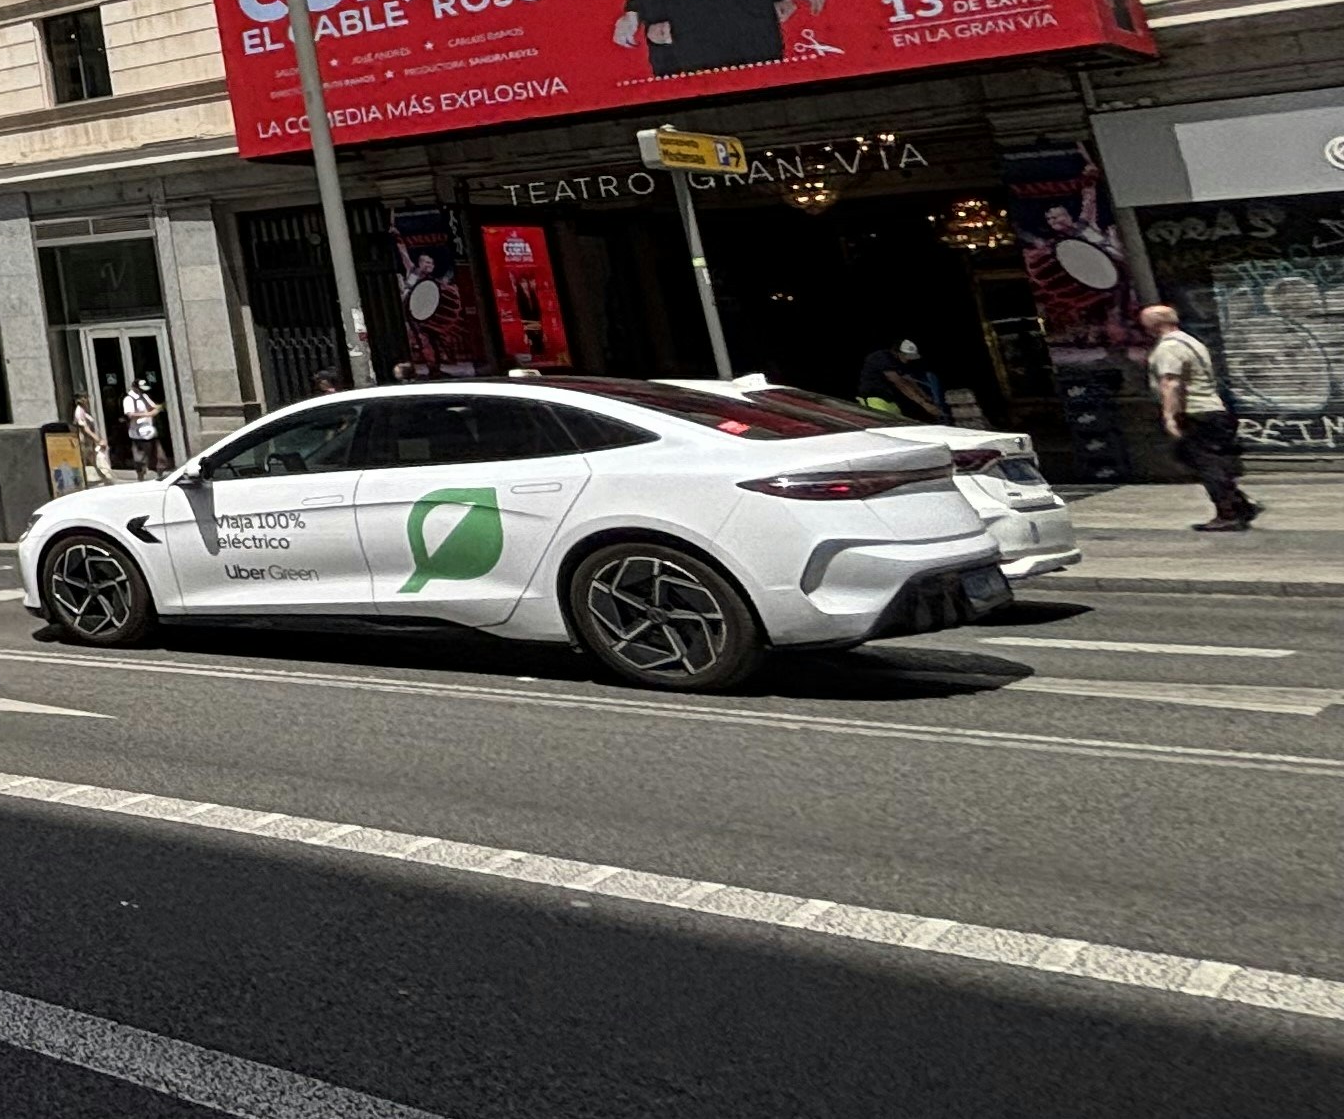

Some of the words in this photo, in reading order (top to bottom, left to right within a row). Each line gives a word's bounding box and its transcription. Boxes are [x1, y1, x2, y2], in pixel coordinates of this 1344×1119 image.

[242, 27, 285, 55] EL
[893, 31, 921, 47] EN
[925, 28, 952, 43] LA
[955, 17, 1016, 38] GRAN
[1016, 11, 1059, 29] VÍA
[257, 119, 282, 139] LA
[387, 92, 436, 119] MÁS
[439, 75, 569, 112] EXPLOSIVA
[502, 172, 655, 206] TEATRO
[831, 143, 930, 175] VIA
[256, 512, 306, 530] 100%
[216, 533, 290, 550] eléctrico
[224, 564, 266, 581] Uber
[268, 564, 320, 582] Green
